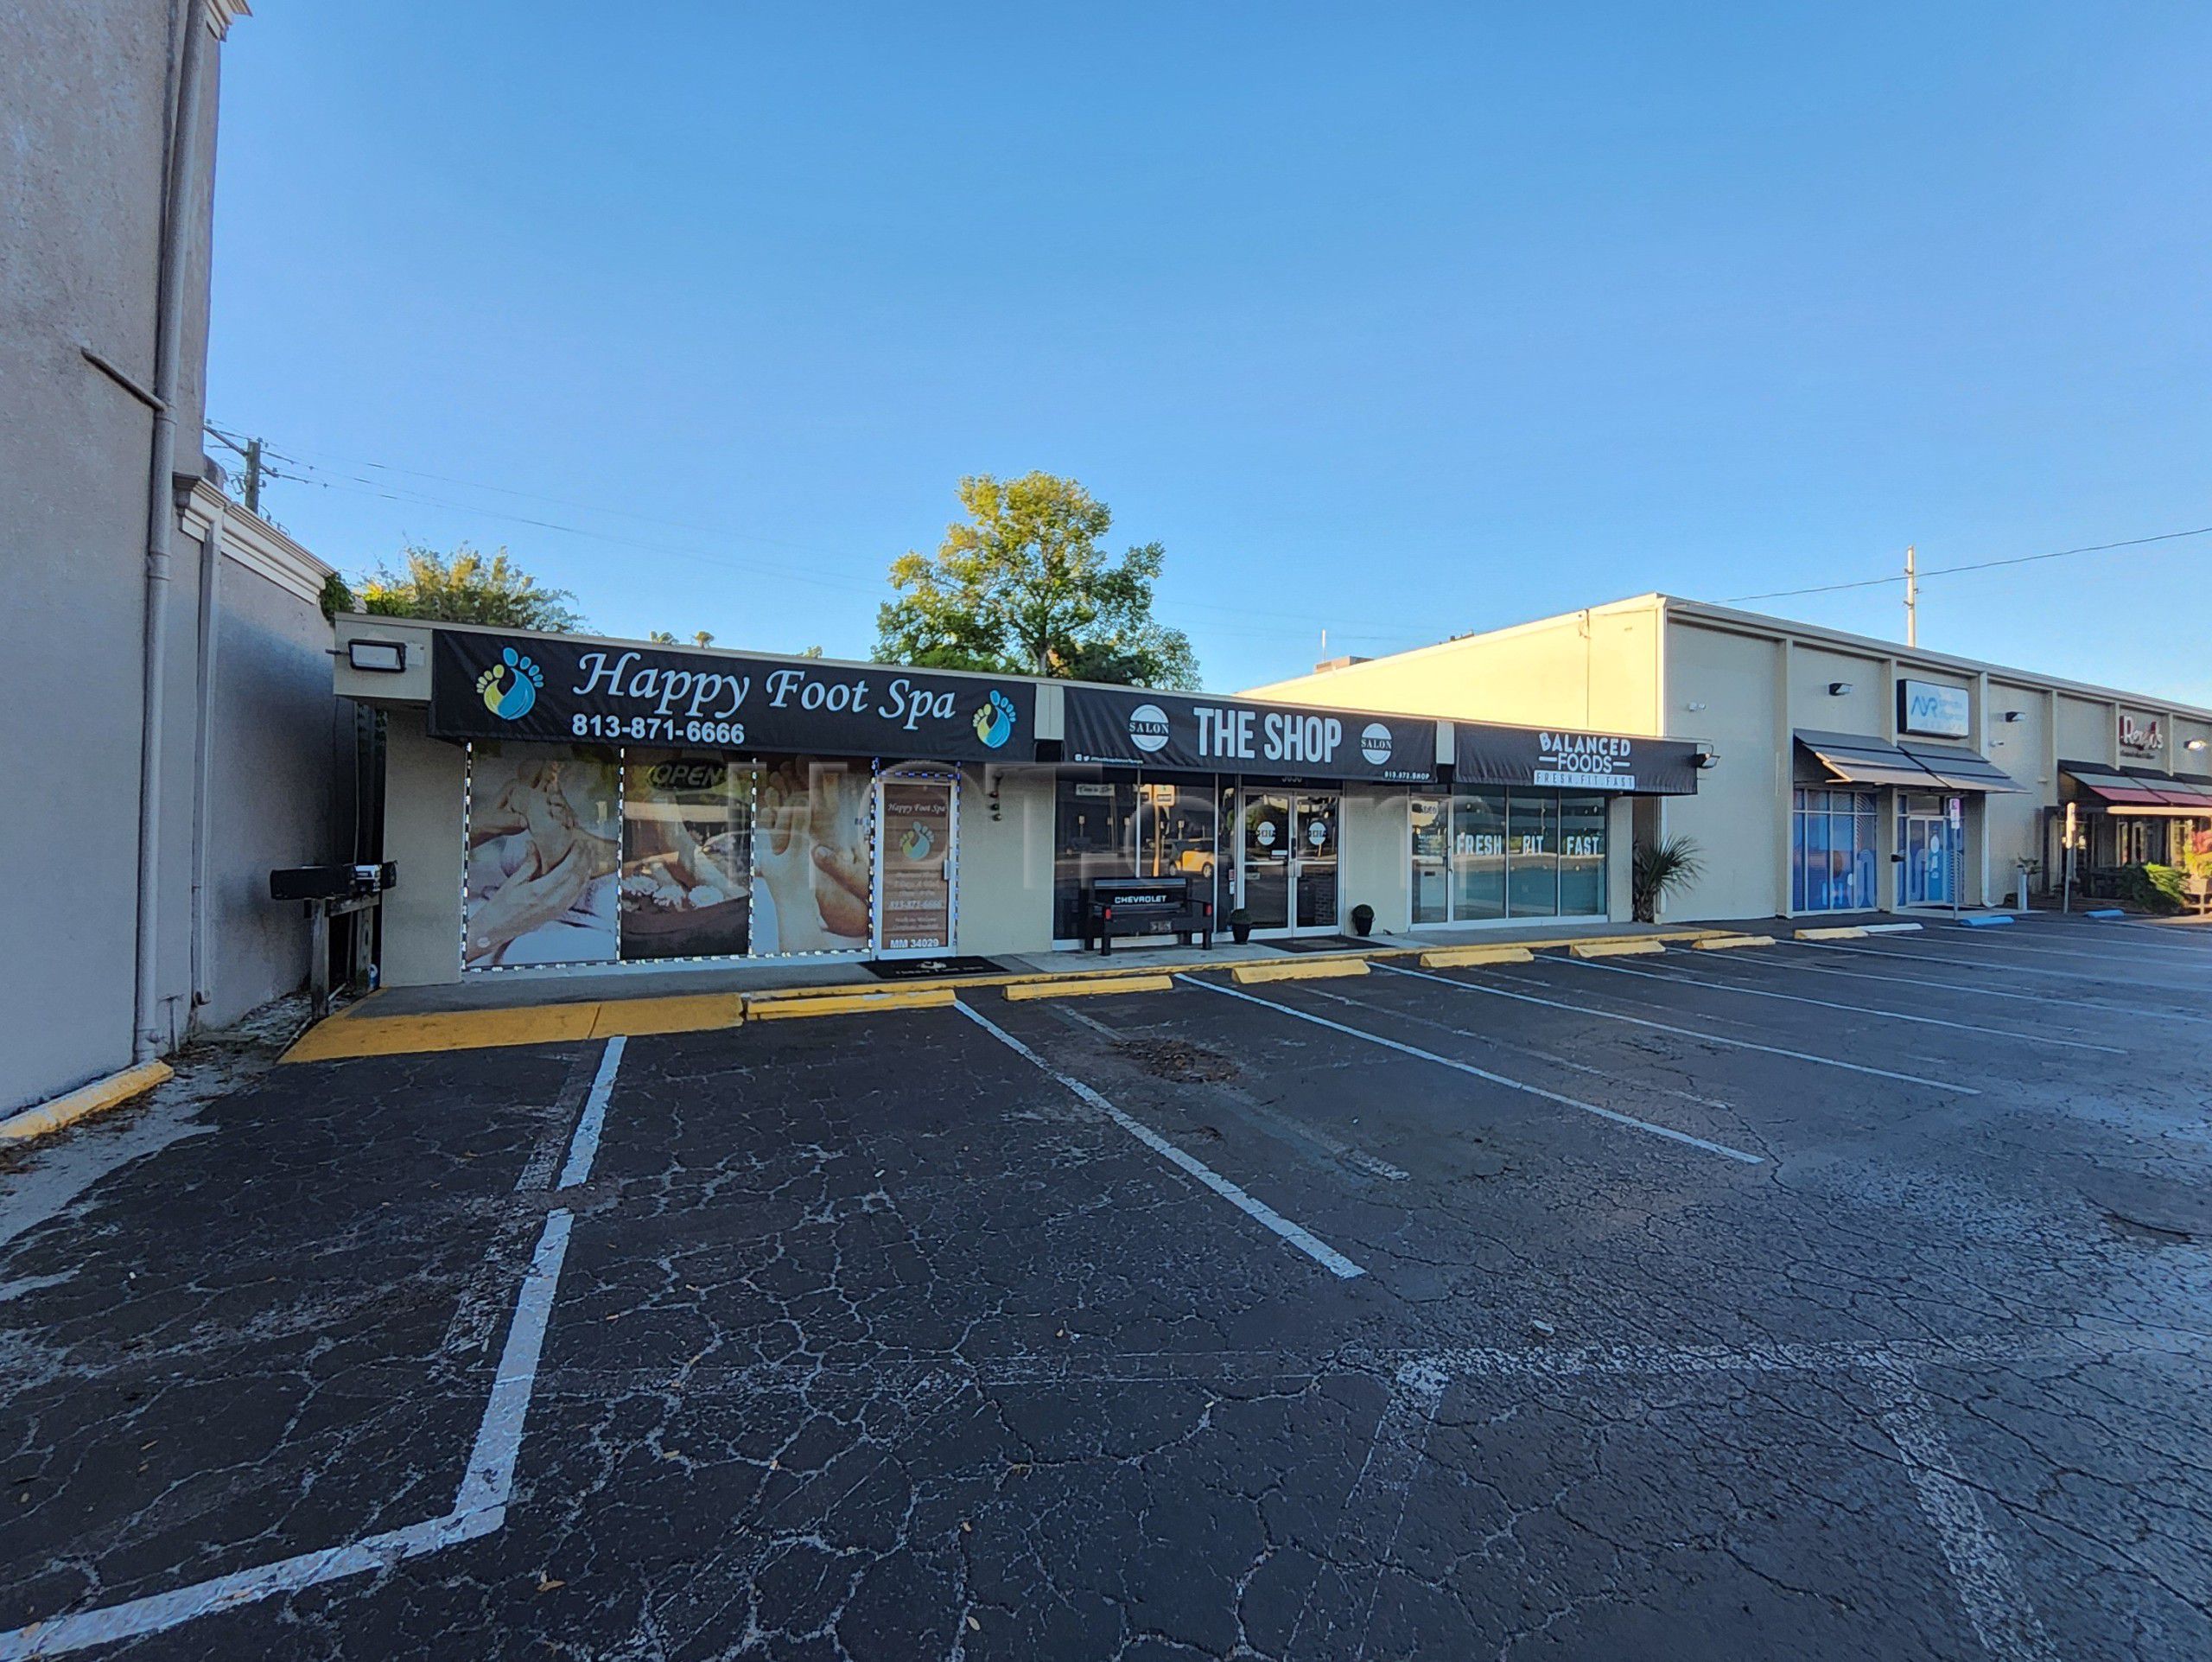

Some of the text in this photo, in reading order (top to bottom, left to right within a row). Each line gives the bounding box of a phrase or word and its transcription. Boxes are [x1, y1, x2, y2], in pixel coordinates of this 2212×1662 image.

[572, 652, 957, 731] Happy Foot Spa
[571, 713, 746, 745] 813-871-6666
[1128, 722, 1169, 735] SALON
[1192, 706, 1343, 764] THE SHOP
[1361, 738, 1393, 749] SALON
[1539, 732, 1631, 757] BALANCED
[1558, 752, 1612, 774] FOODS
[652, 764, 724, 786] OPEN
[887, 802, 946, 814] Happy Foot Spa
[1456, 834, 1502, 856] FRESH
[1567, 835, 1600, 856] FAST
[1114, 895, 1167, 904] CHEVROLET
[890, 938, 940, 949] MM 34029
